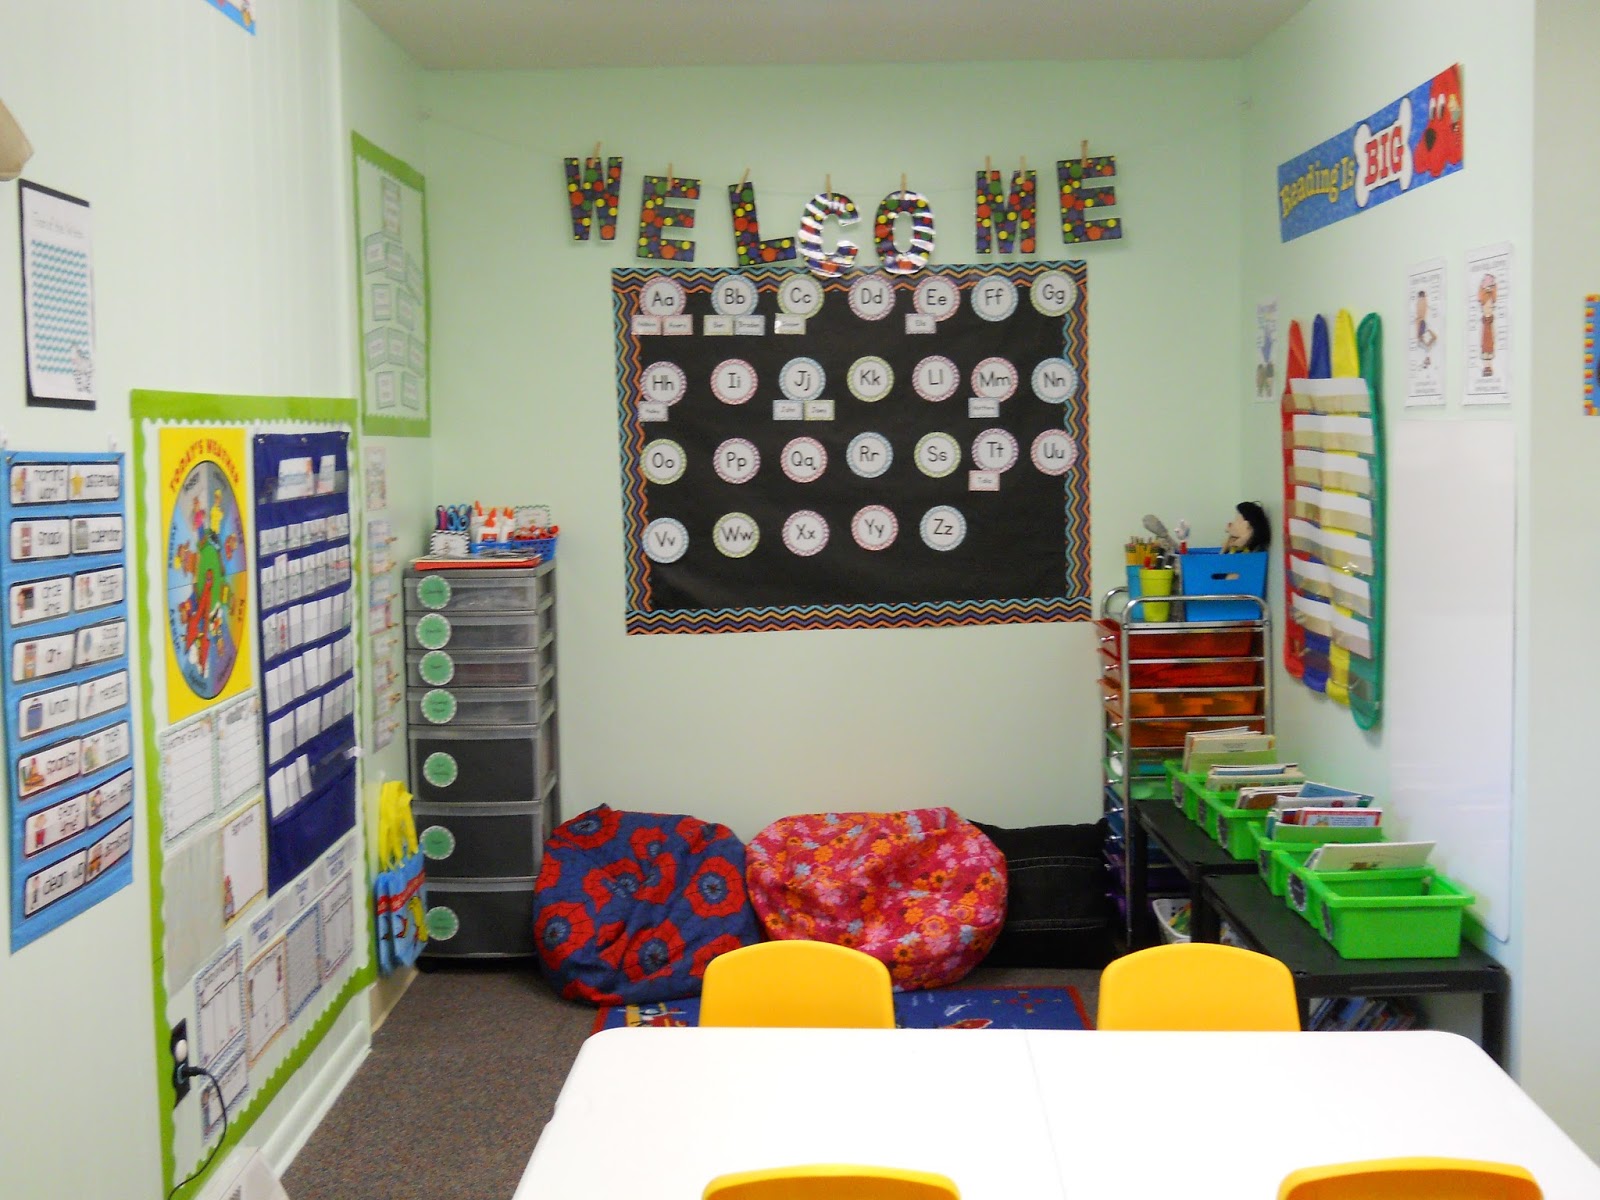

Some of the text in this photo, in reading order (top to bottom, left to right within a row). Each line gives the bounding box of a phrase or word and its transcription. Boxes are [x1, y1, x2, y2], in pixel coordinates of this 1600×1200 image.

[1280, 161, 1339, 219] Reading
[1364, 125, 1405, 187] BIG
[563, 154, 1123, 278] WELCOME
[651, 290, 674, 308] Aa
[724, 287, 746, 305] Bb
[860, 287, 883, 305] Dd
[926, 288, 947, 306] Ee
[984, 288, 1004, 306] Ff
[1042, 283, 1065, 305] Gg
[652, 374, 674, 392] Hh
[726, 372, 742, 389] Ii
[793, 370, 812, 392] Jj
[859, 369, 882, 387] Kk
[978, 371, 1011, 388] Mm
[1043, 371, 1067, 388] Nn
[859, 445, 880, 463] Rr
[927, 445, 947, 462] Ss
[986, 441, 1004, 458] Tt
[1043, 442, 1065, 460] Uu
[651, 452, 675, 469] Oo
[726, 451, 747, 472] Pp
[720, 525, 755, 542] Ww
[795, 523, 816, 540] Xx
[864, 519, 884, 538] Yy
[933, 518, 954, 536] Zz
[654, 531, 676, 547] Vv
